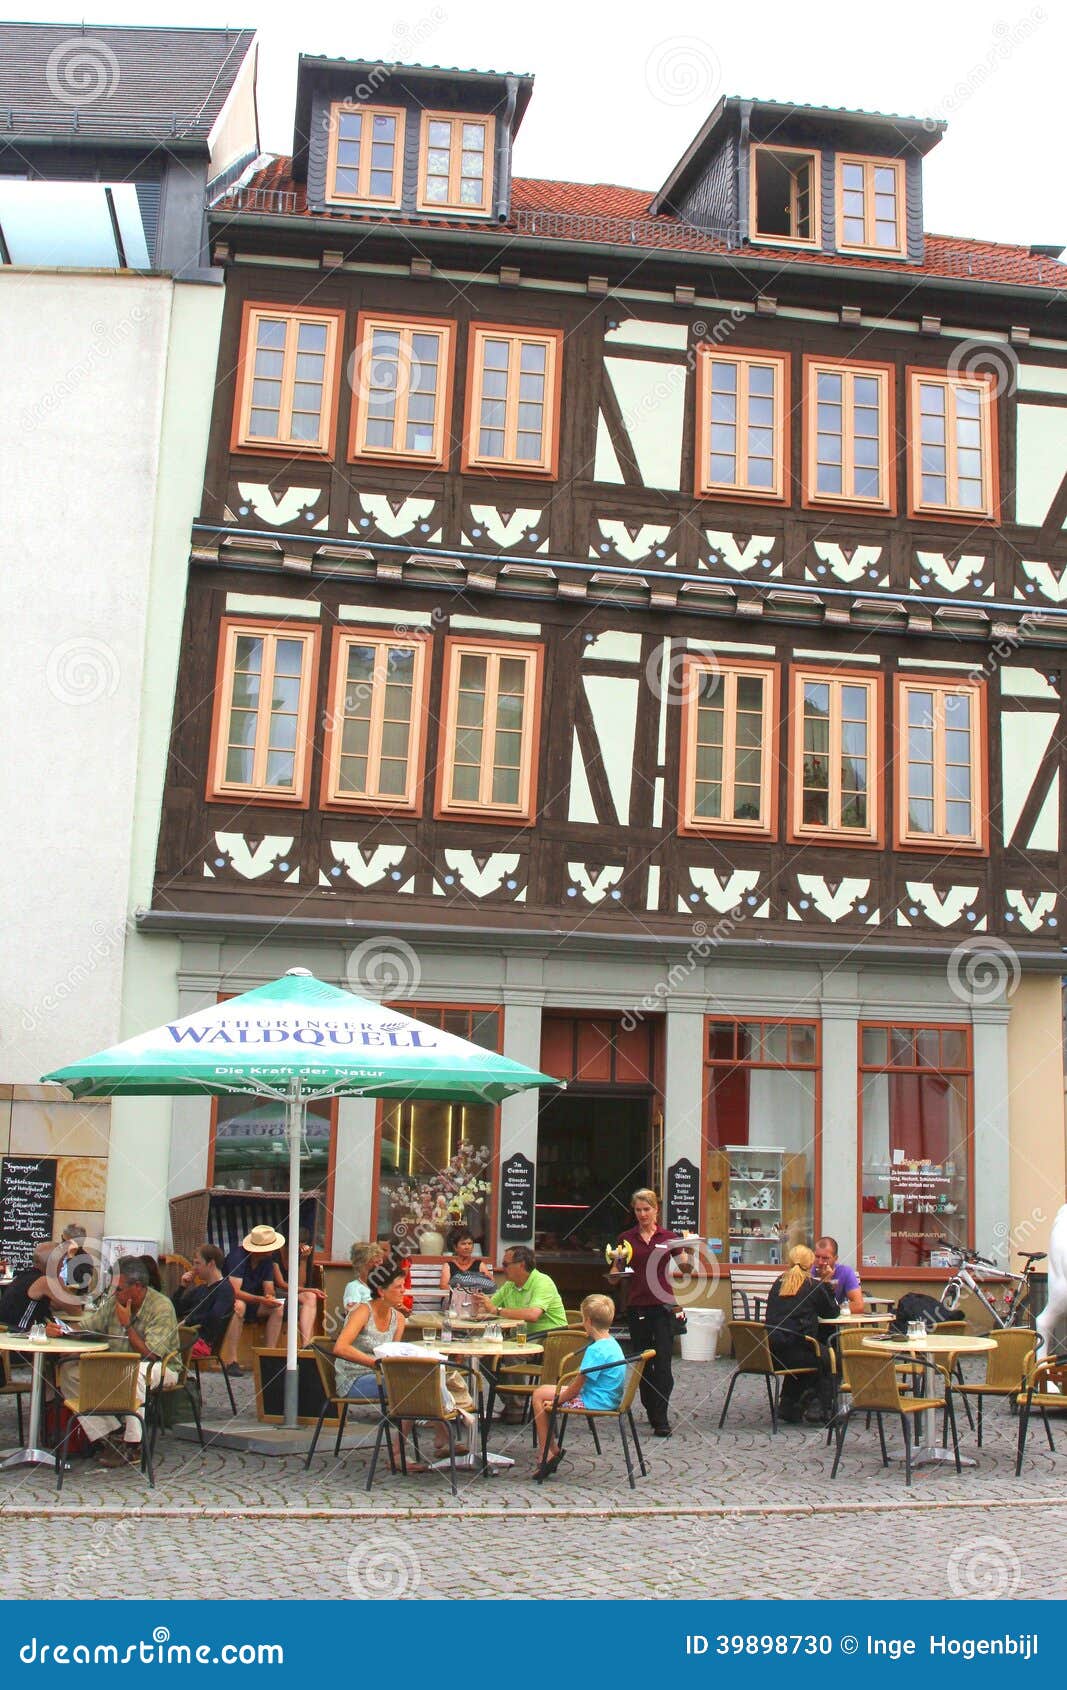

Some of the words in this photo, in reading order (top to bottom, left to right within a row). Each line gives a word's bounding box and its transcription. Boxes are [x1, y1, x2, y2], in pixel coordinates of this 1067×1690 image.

[167, 1026, 437, 1047] WALDQUELL
[300, 1067, 330, 1075] der
[335, 1068, 385, 1077] Natur
